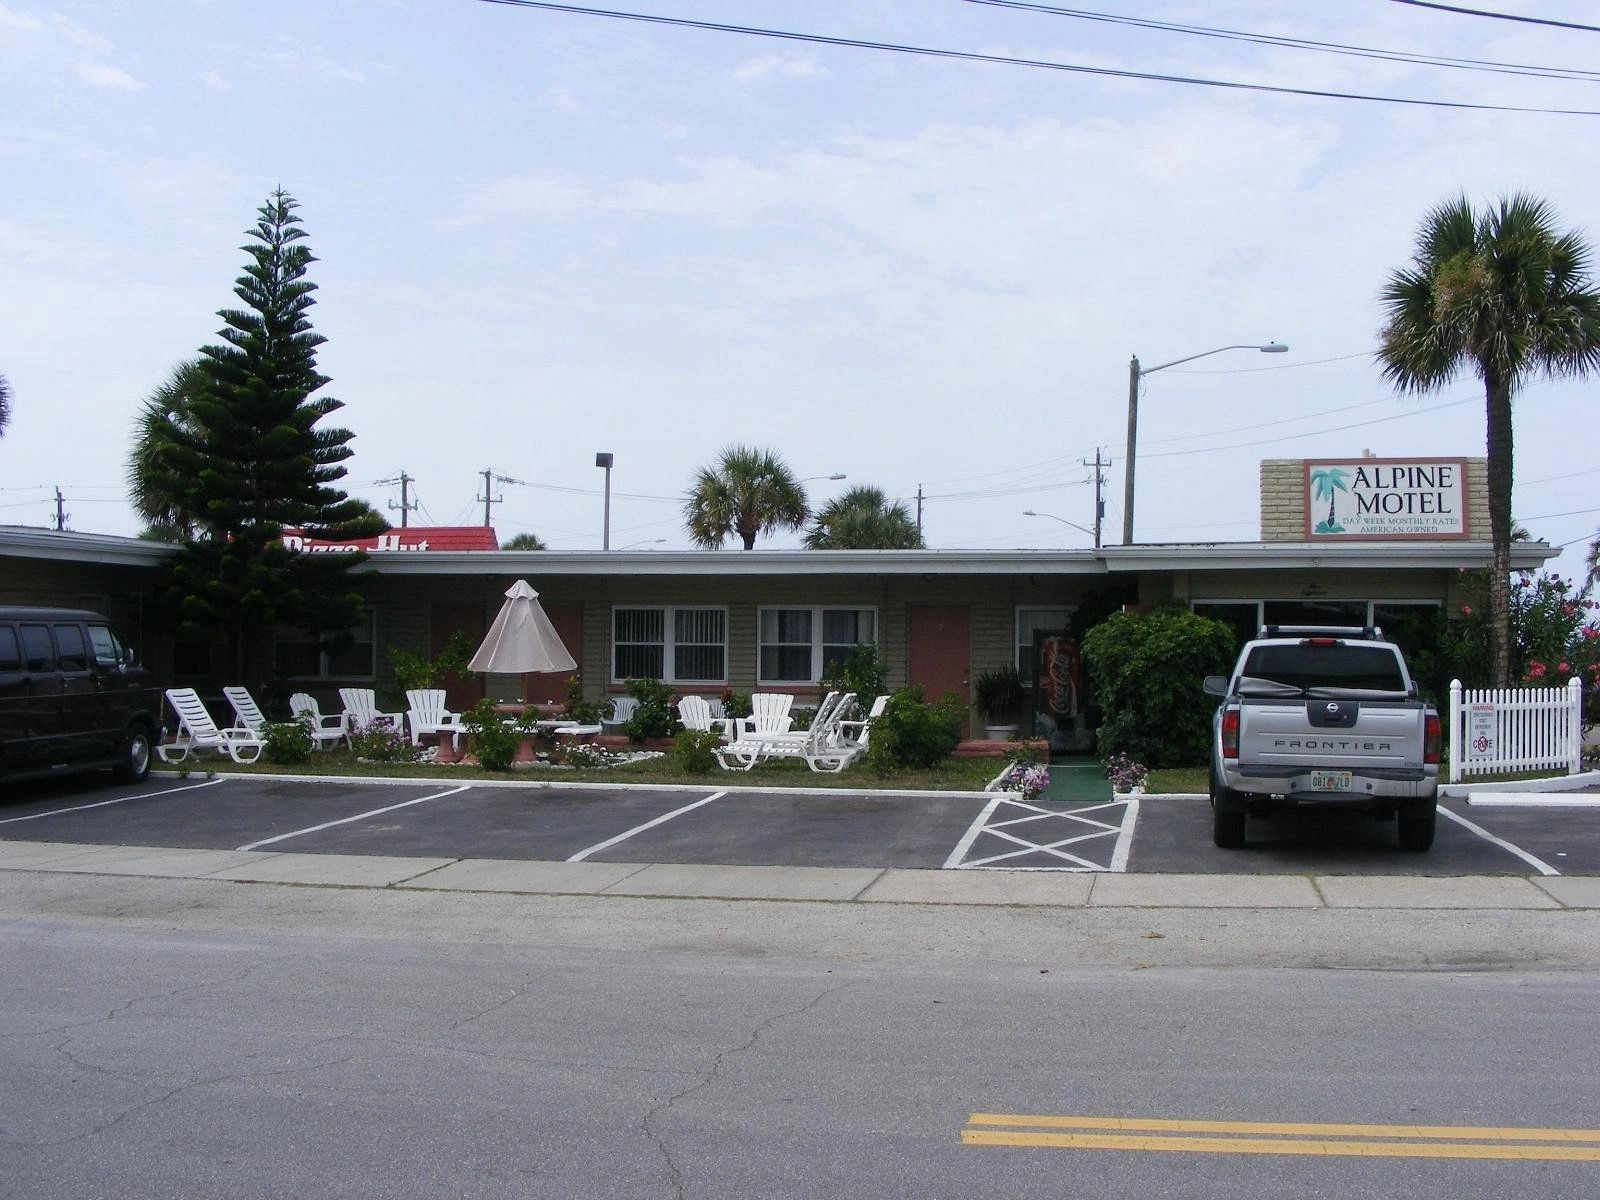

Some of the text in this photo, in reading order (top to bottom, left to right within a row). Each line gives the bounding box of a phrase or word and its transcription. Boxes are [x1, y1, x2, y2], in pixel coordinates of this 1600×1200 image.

[1352, 466, 1453, 490] ALPINE
[1354, 492, 1452, 517] MOTEL
[1343, 517, 1459, 525] DAY WEEK MONTHLY RATES
[1360, 525, 1438, 533] AMERICAN OWNED
[1275, 740, 1391, 751] FRONTIER
